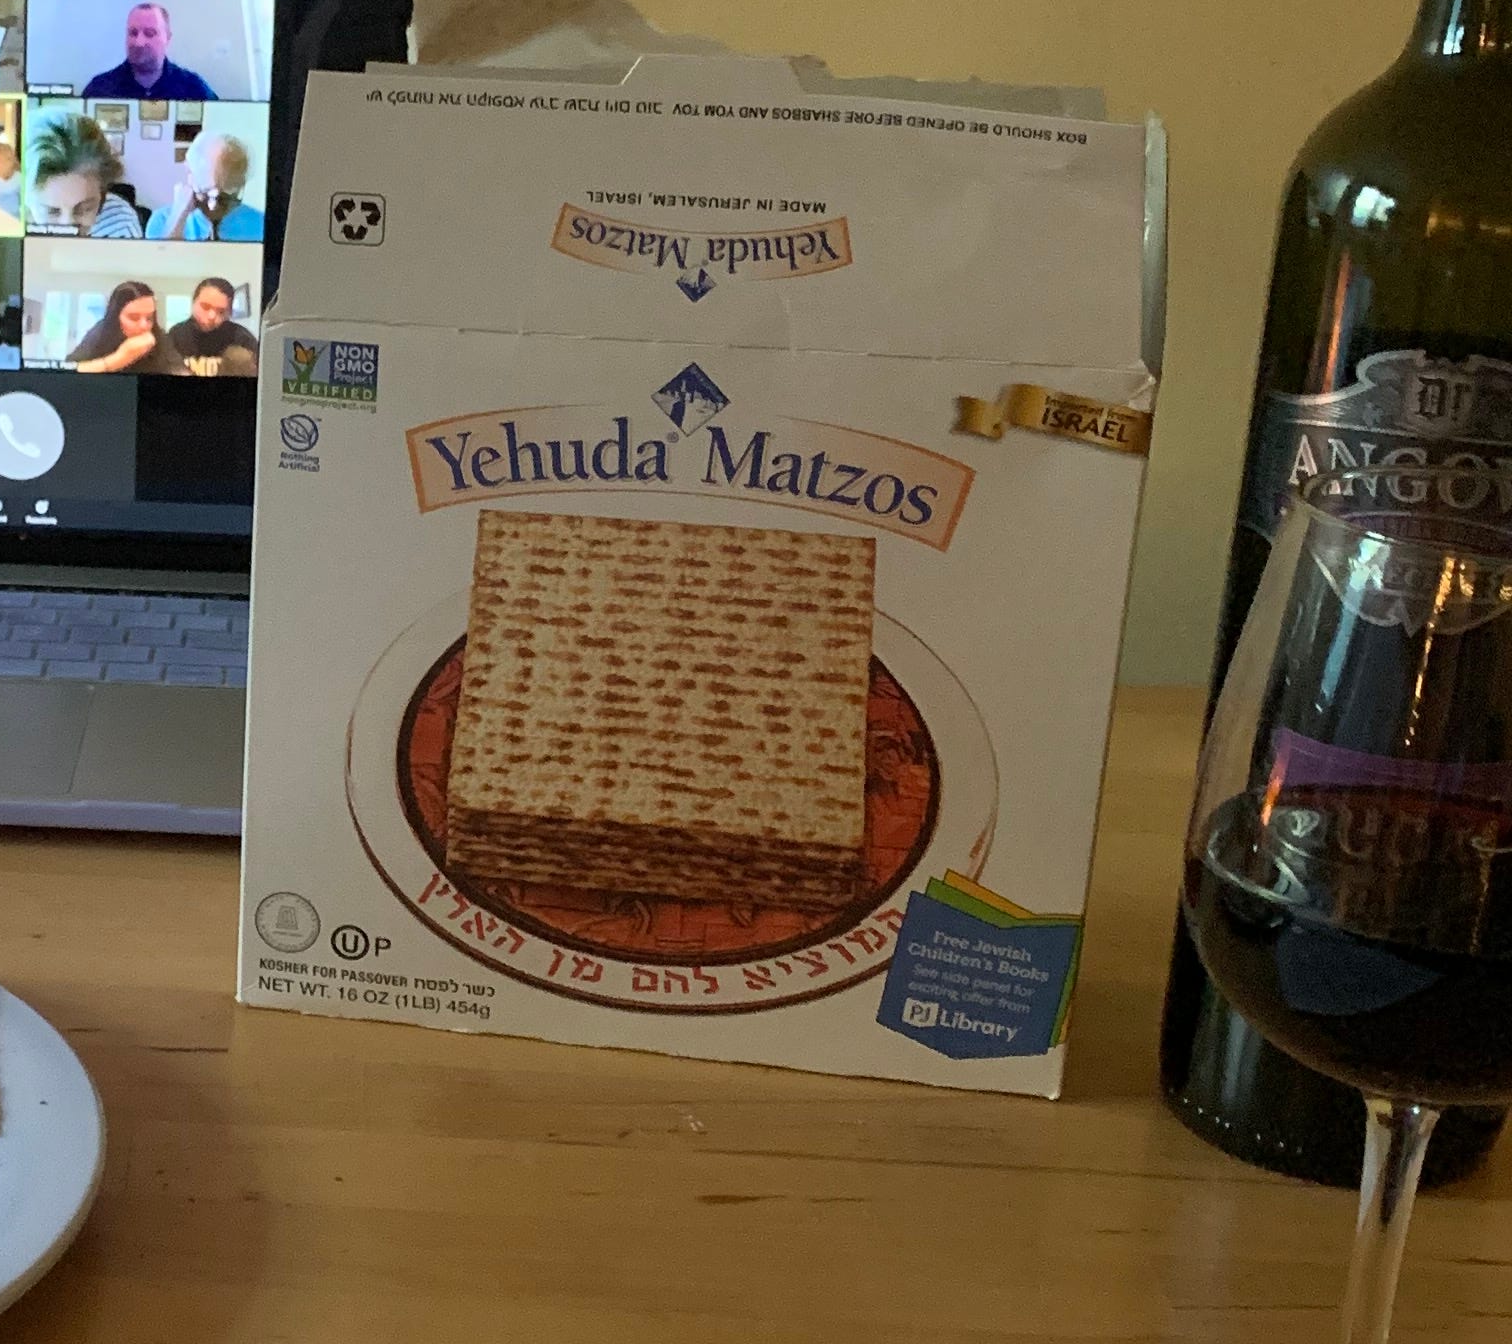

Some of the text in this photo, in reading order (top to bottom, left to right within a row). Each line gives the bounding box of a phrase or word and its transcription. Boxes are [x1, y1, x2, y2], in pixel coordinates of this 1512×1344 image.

[672, 103, 1087, 146] BOX SHOULD BE OPENED BEFORE SHABBOS AND YOM TOV
[587, 190, 826, 214] MADE IN JERUSALEM, ISRAEL
[571, 216, 689, 270] Matzos
[334, 358, 375, 374] GMO
[335, 345, 374, 360] NON
[288, 382, 373, 400] VERIFIED
[1042, 407, 1129, 442] ISRAEL
[702, 426, 938, 526] Matzos
[908, 942, 1049, 982] Children's Books
[933, 930, 1031, 962] Free Jewish
[259, 957, 408, 988] KOSHER FOR PASSOVER
[414, 976, 496, 998] כשר לפסח
[972, 978, 1011, 995] panel
[1013, 983, 1035, 997] for
[259, 976, 294, 993] NET
[300, 981, 331, 999] WT.
[339, 987, 358, 1001] 16
[363, 989, 390, 1006] OZ
[446, 1000, 491, 1019] 454g
[910, 1005, 1017, 1042] PJ Library
